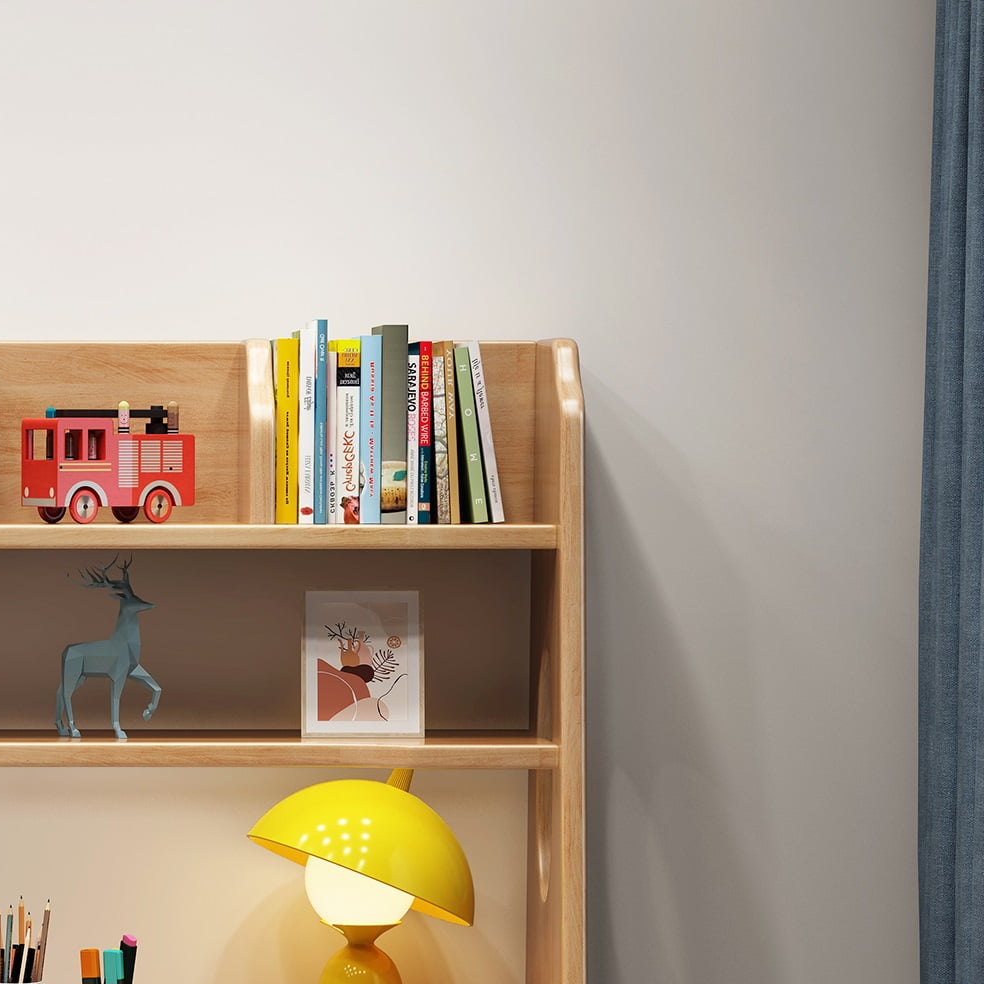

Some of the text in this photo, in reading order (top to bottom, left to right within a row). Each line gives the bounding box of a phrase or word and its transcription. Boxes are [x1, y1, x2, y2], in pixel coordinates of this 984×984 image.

[407, 362, 417, 442] SARAJEVO ROSES
[420, 354, 430, 444] BEHIND BARBED WIRE
